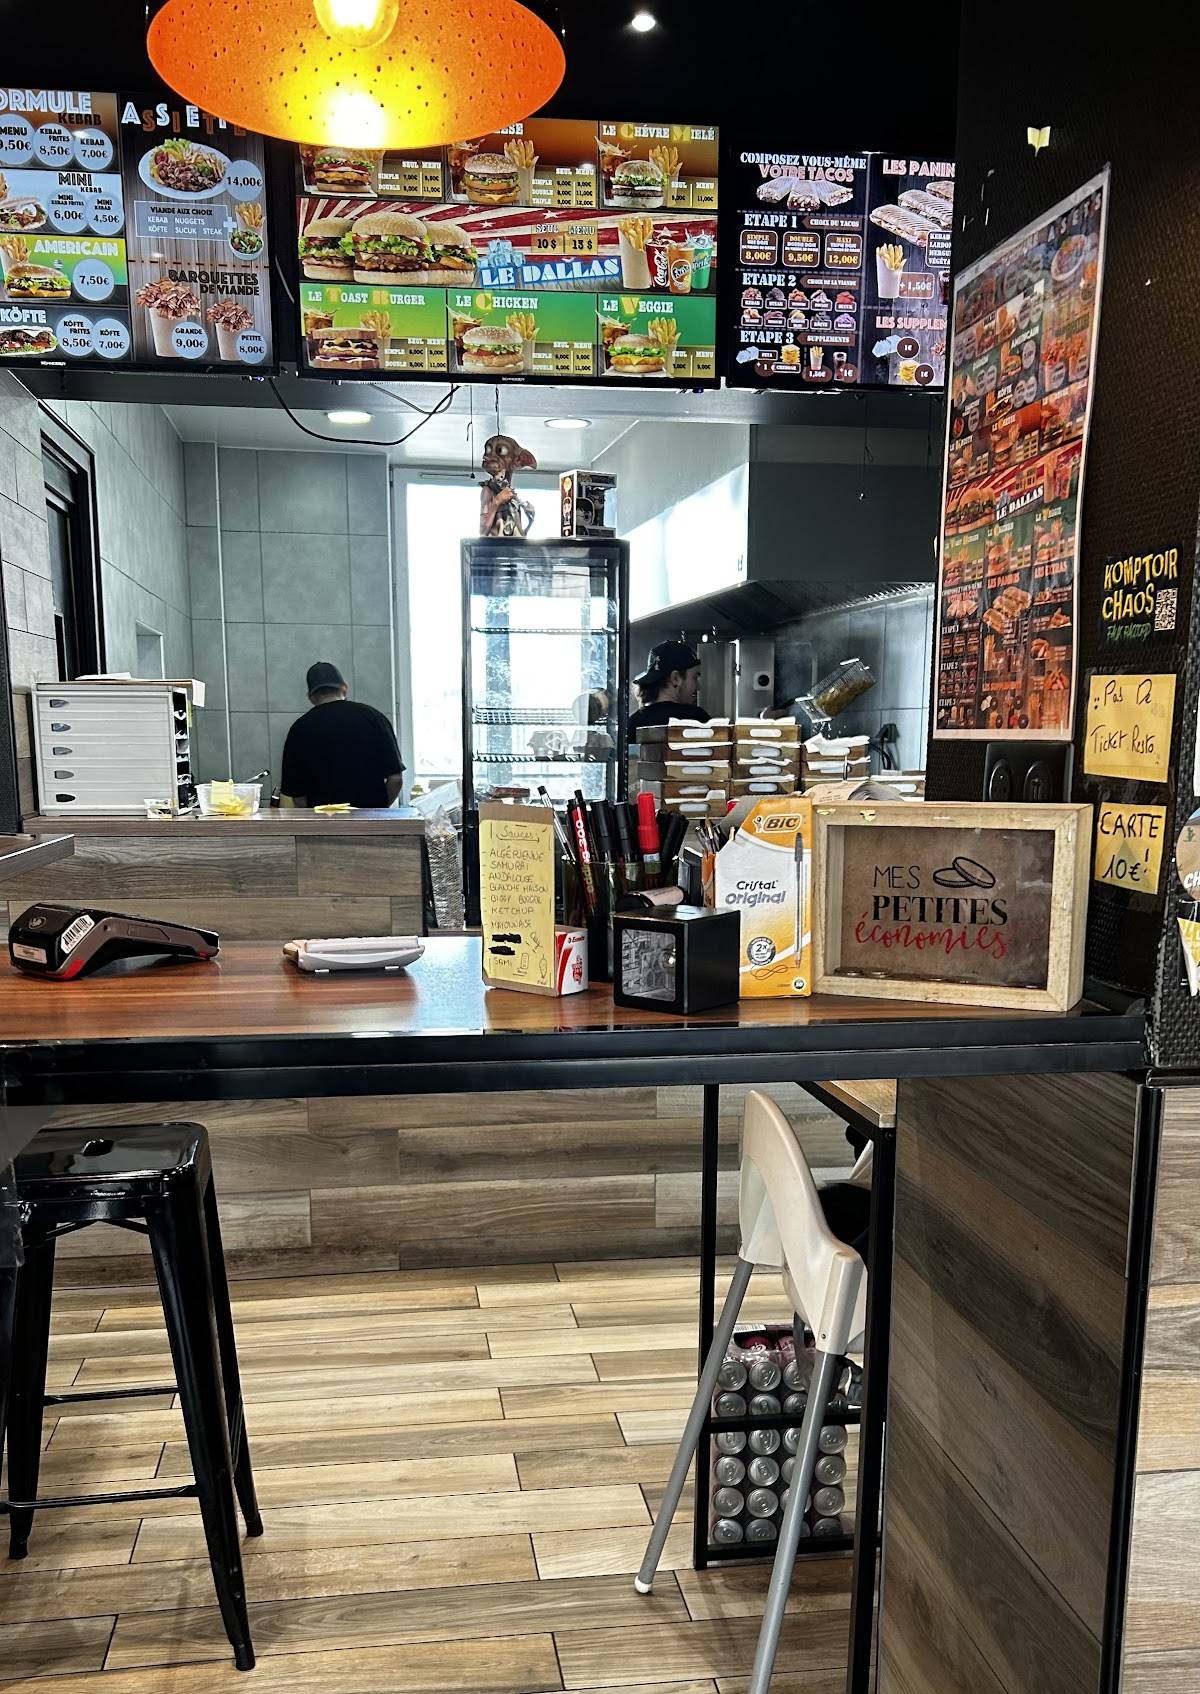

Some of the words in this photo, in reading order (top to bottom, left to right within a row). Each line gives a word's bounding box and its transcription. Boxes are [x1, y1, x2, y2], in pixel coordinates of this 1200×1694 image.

[58, 113, 102, 126] KEBAB
[602, 124, 617, 136] LE
[80, 138, 105, 146] KEBAB
[39, 145, 70, 156] 8,50€
[81, 149, 108, 158] 7,00€
[740, 152, 800, 166] COMPOSEZ
[802, 155, 867, 170] VOUS-MÊME
[759, 164, 806, 180] VOTRE
[808, 166, 855, 182] TACOS
[882, 159, 907, 175] LES
[908, 160, 956, 178] PANIN
[58, 172, 93, 187] MINI
[226, 176, 262, 187] 14,00€
[80, 186, 102, 194] KEBAB
[54, 209, 84, 220] 6,00€
[150, 206, 175, 214] VIANDE
[191, 208, 213, 216] CHOIX
[93, 214, 120, 224] 4,50€
[147, 216, 169, 224] KEBAB
[175, 217, 205, 226] NUGGETS
[744, 213, 788, 228] ETAPE
[790, 215, 798, 229] 1
[840, 219, 860, 228] TACOS
[148, 225, 168, 234] KÖFTE
[175, 226, 197, 235] SUCUK
[203, 228, 223, 236] STEAK
[536, 224, 560, 233] SEUL
[568, 226, 596, 236] MENU
[34, 239, 119, 257] AMERICAIN
[537, 239, 549, 249] 10
[550, 239, 558, 250] $
[586, 240, 594, 250] $
[745, 251, 772, 261] 8,00€
[788, 253, 814, 263] 9,50€
[828, 254, 858, 265] 12,00€
[168, 269, 259, 286] BARQUETTES
[481, 269, 515, 287] LE
[522, 257, 620, 284] DALLAS
[79, 275, 110, 286] 7,50€
[742, 272, 784, 287] ETAPE
[787, 274, 797, 287] 2
[200, 284, 216, 294] DE
[216, 285, 260, 296] VIANDE
[907, 281, 932, 291] 1,50€
[307, 291, 322, 302] LE
[456, 295, 472, 306] LE
[475, 292, 539, 310] CHICKEN
[602, 299, 619, 312] LE
[621, 296, 674, 315] VEGGIE
[0, 306, 47, 324] KÖFTE
[63, 320, 85, 328] KÖFTE
[875, 316, 896, 329] LES
[100, 329, 121, 337] KÖFTE
[175, 327, 203, 335] GRANDE
[740, 329, 782, 344] ETAPE
[785, 332, 794, 344] 3
[62, 338, 92, 348] 8,50€
[99, 340, 125, 350] 7,00€
[176, 338, 205, 349] 9,00€
[239, 345, 265, 354] 8,00€
[1009, 485, 1044, 514] DALLAS
[1102, 583, 1155, 621] CHAOS
[1090, 724, 1129, 754] Ticket
[1131, 724, 1156, 754] Resto
[766, 817, 799, 829] BIC
[1100, 811, 1162, 838] CARTE
[490, 845, 544, 862] ALGÉRIENNE
[873, 865, 921, 889] MES
[725, 890, 787, 908] Original
[491, 906, 535, 915] KETCHUP
[871, 894, 1009, 926] PETITES
[854, 911, 1008, 960] économies
